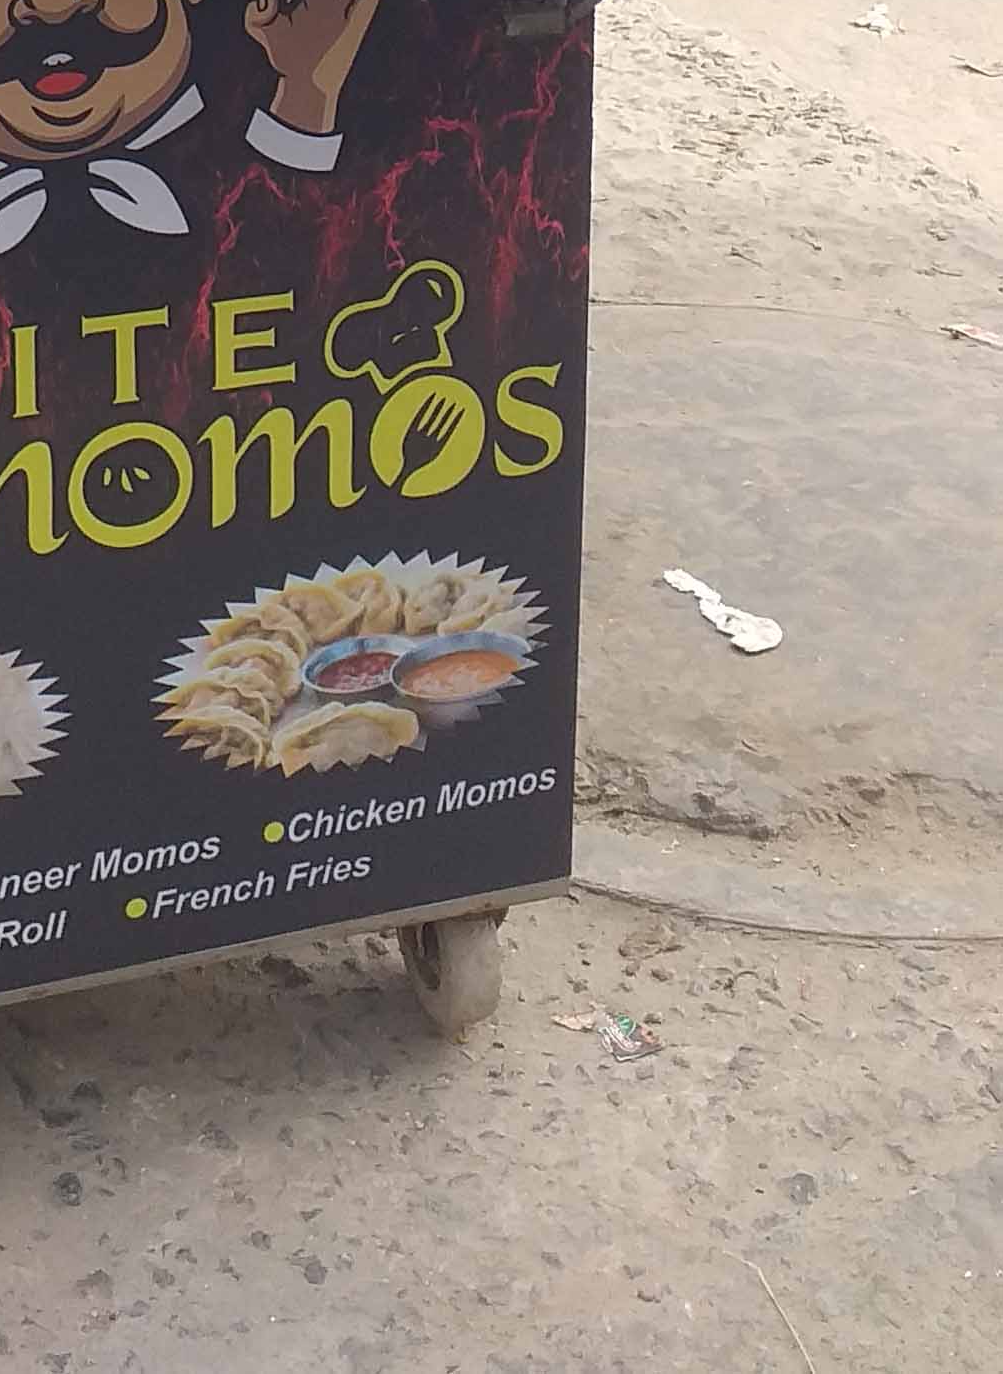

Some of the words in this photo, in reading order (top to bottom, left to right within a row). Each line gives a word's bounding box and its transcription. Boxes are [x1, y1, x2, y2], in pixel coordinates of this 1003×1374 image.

[90, 835, 221, 882] Momos
[287, 796, 426, 843] Chicken
[436, 766, 557, 815] Momos
[152, 869, 275, 920] French
[285, 853, 372, 893] Fries
